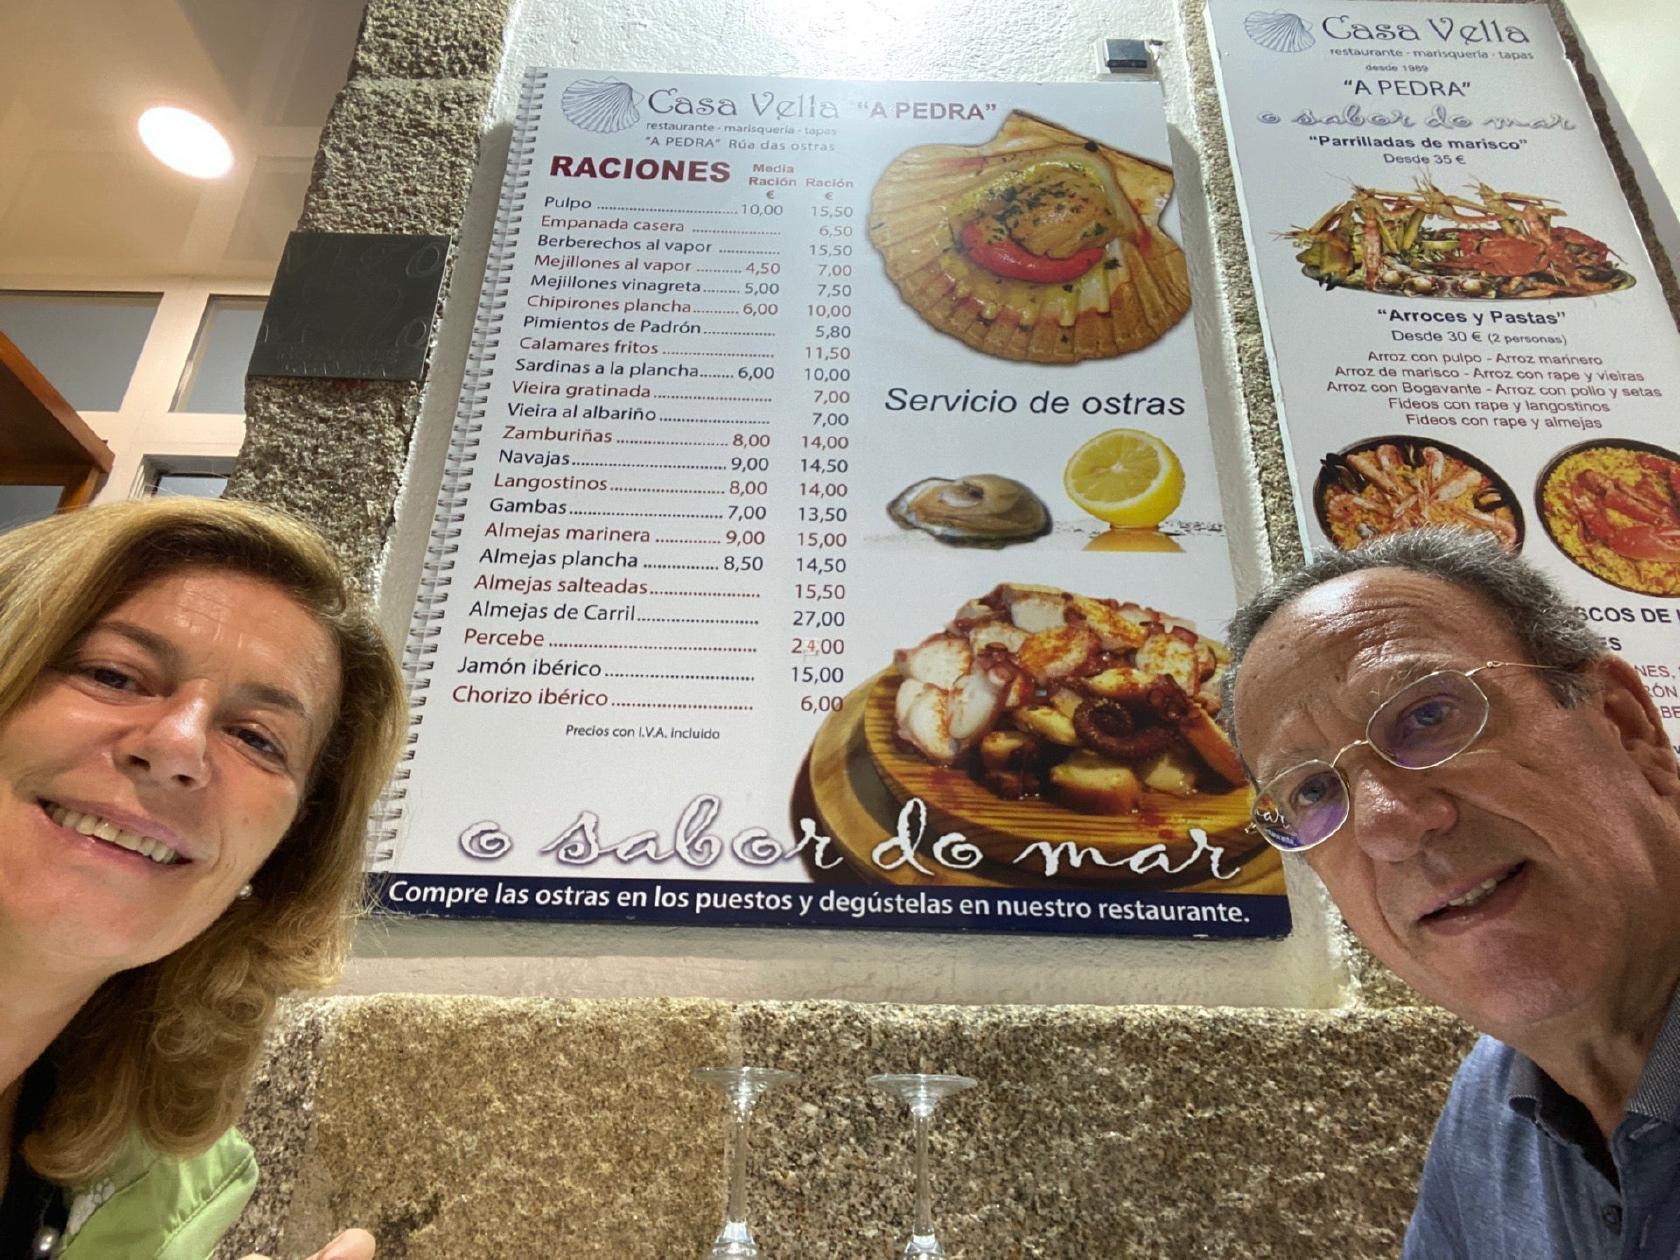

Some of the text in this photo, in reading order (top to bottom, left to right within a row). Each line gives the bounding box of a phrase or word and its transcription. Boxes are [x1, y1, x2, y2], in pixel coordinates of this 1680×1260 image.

[1322, 15, 1530, 44] Casa Vella
[1330, 47, 1534, 61] restaurante marisquería tapas
[648, 88, 738, 117] Casa
[750, 91, 839, 119] Vella
[646, 121, 837, 138] restaurante marisquería tapas
[729, 139, 755, 150] Rúa
[760, 140, 787, 151] das
[792, 142, 835, 152] ostras
[1421, 137, 1443, 148] de
[550, 156, 731, 182] RACIONES
[753, 163, 794, 174] Media
[1384, 153, 1466, 165] Desde 35 €
[749, 176, 853, 188] Ración Ración
[544, 197, 853, 219] Pulpo 10,00 15,50
[541, 216, 853, 238] Empanada casera 6,50
[538, 235, 852, 258] Berberechos al vapor 15,50
[534, 255, 852, 278] Mejillones al vapor 4,50 7,00
[531, 275, 852, 298] Mejillones vinagreta 5,00 7,50
[527, 295, 851, 319] Chipirones plancha 6,00 10,00
[1474, 312, 1484, 325] y
[523, 316, 851, 340] Pimientos de Padrón 5,80
[1392, 330, 1567, 346] Desde 30 € (2 personas)
[519, 337, 850, 361] Calamares fritos 11,50
[1368, 352, 1602, 366] Arroz con pulpo Arroz marinero
[515, 358, 850, 383] Sardinas a la plancha 6,00 10,00
[1335, 366, 1644, 382] Arroz de marisco Arroz con rape y vieiras
[513, 380, 850, 405] Vieira gratinada 7,00
[885, 388, 1186, 416] Servicio de ostras
[508, 403, 849, 427] Vieira al albariño 7,00
[503, 425, 849, 450] Zamburiñas 8,00 14,00
[499, 449, 848, 474] Navajas 9,00 14,50
[494, 472, 848, 498] Langostinos 8,00 14,00
[489, 498, 847, 523] Gambas 7,00 13,50
[485, 522, 847, 549] Almejas marinera 9,00 15,00
[479, 548, 846, 574] Almejas plancha 8,50 14,50
[474, 574, 845, 601] Almejas salteadas 15,50
[469, 601, 845, 628] Almejas de Carril 27,00
[464, 628, 544, 648] Percebe
[458, 656, 844, 684] Jamón ibérico 15,00
[452, 685, 844, 713] Chorizo ibérico 6,00
[566, 725, 720, 740] Precios con I.V.A. incluido
[458, 792, 1241, 881] o sabor do mar
[389, 881, 1250, 923] Compre las ostras en los puestos y degústelas en nuestro restaurante.
